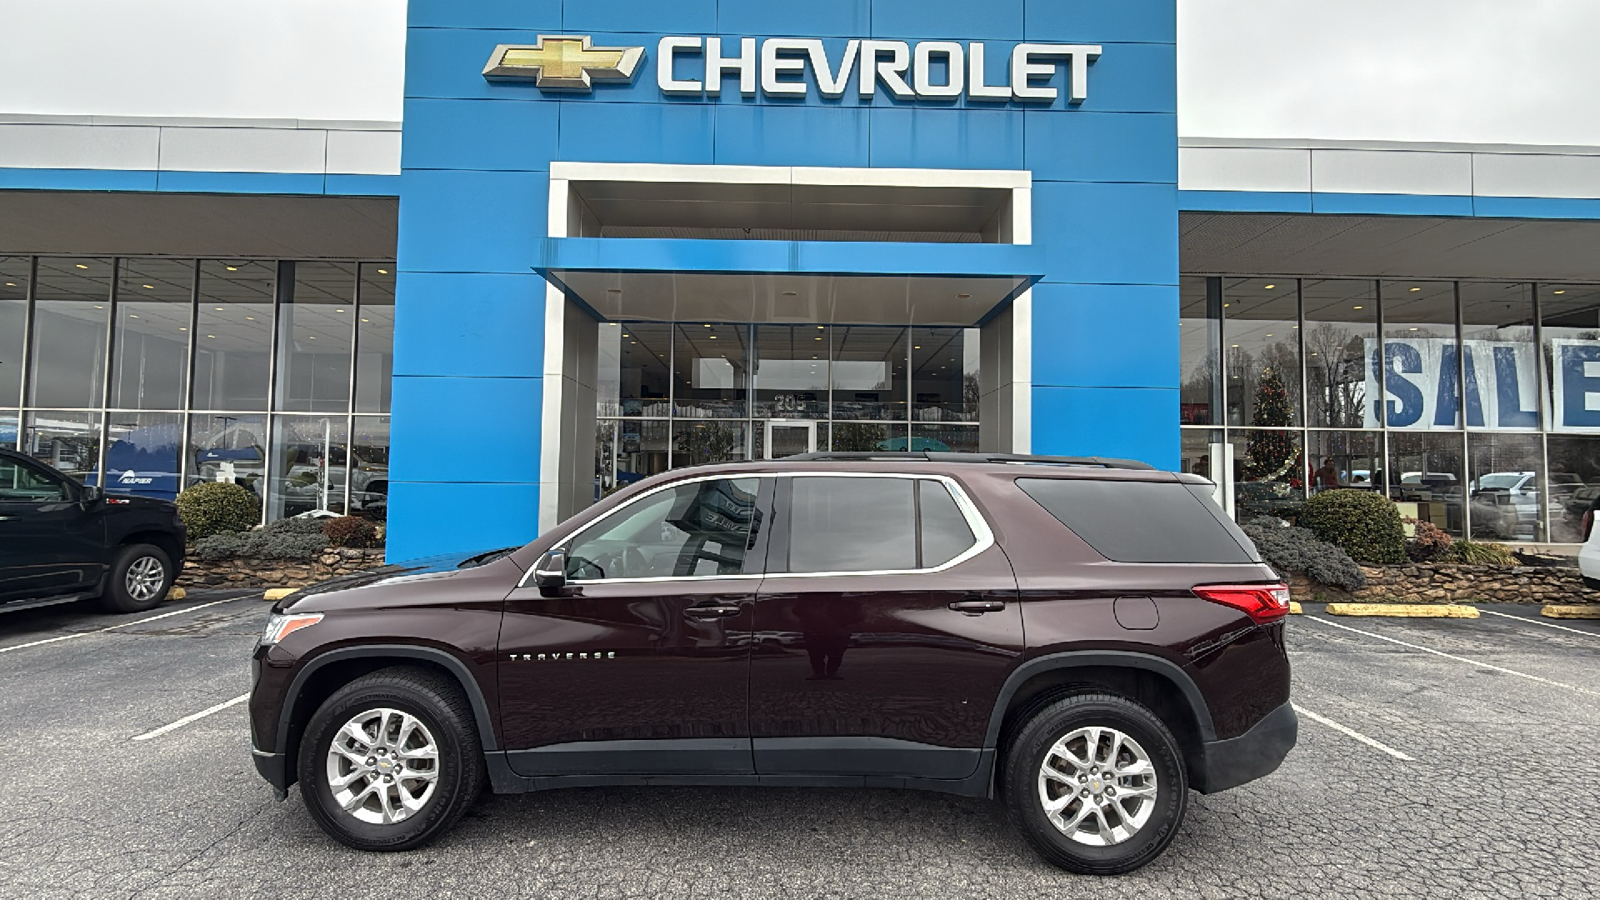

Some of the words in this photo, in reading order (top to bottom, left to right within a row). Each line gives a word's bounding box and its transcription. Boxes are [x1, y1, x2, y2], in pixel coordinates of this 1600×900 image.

[657, 36, 1102, 104] CHEVROLET
[774, 393, 807, 411] 205
[1372, 342, 1600, 427] SALE
[509, 651, 616, 661] TRAVERSE
